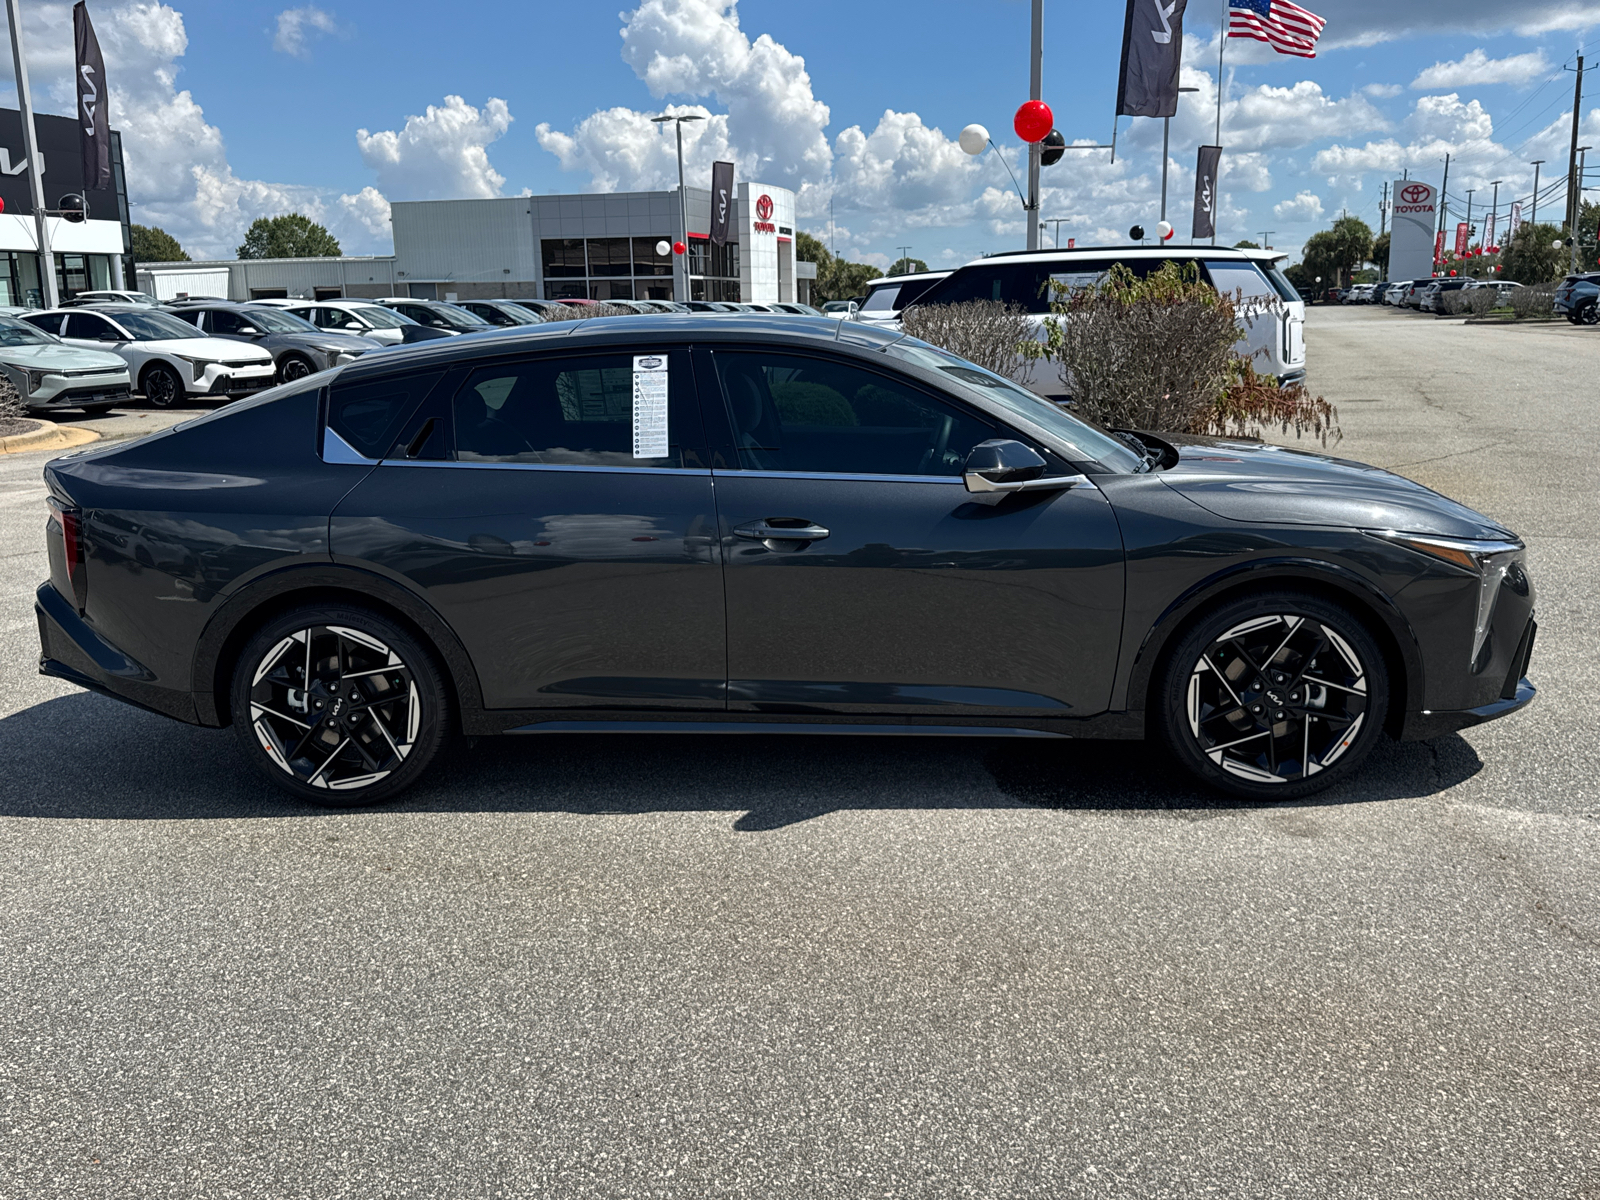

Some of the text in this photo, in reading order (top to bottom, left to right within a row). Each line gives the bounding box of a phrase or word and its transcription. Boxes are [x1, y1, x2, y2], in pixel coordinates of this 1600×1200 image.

[81, 65, 97, 136] KIA
[719, 189, 727, 224] KIA
[1202, 175, 1211, 212] KIA
[1394, 205, 1434, 213] TOYOTA
[754, 222, 776, 233] TOYOTA
[331, 697, 343, 717] KIA
[1266, 690, 1284, 706] KIA
[238, 715, 264, 764] KUMHO
[1290, 767, 1343, 795] KUMHO
